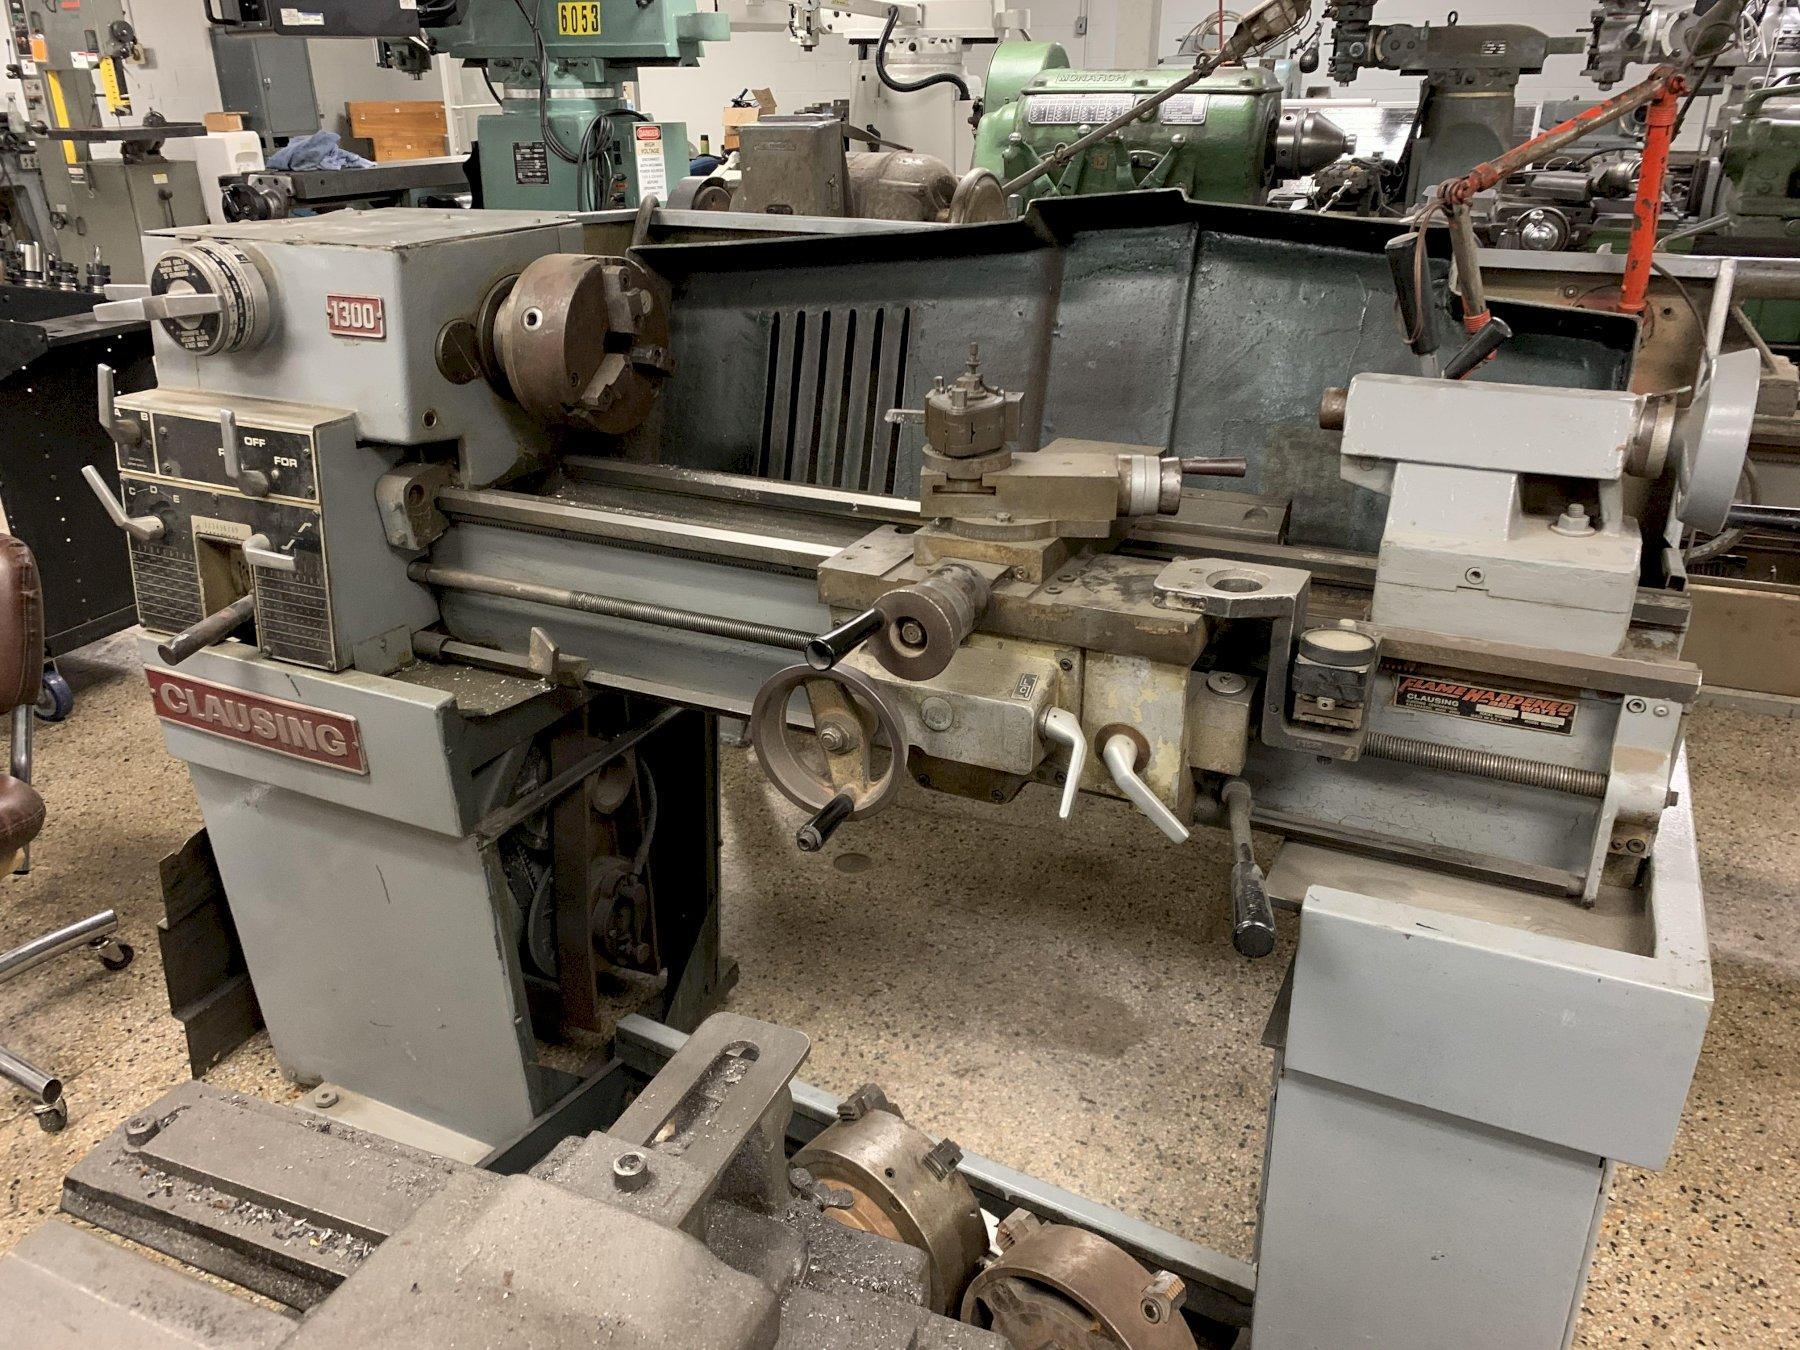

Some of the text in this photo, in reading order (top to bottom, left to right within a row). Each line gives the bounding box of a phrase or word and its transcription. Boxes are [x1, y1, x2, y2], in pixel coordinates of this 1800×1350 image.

[561, 4, 599, 33] 6053
[1059, 73, 1126, 82] MONARCH
[331, 299, 375, 330] 1300
[114, 408, 148, 421] A B
[244, 436, 266, 448] OFF
[274, 456, 298, 468] FOR
[128, 485, 180, 504] C D E
[1398, 677, 1576, 713] FLAME HARDENED
[1406, 693, 1460, 708] CLAUSING
[160, 682, 349, 757] CLAUSING
